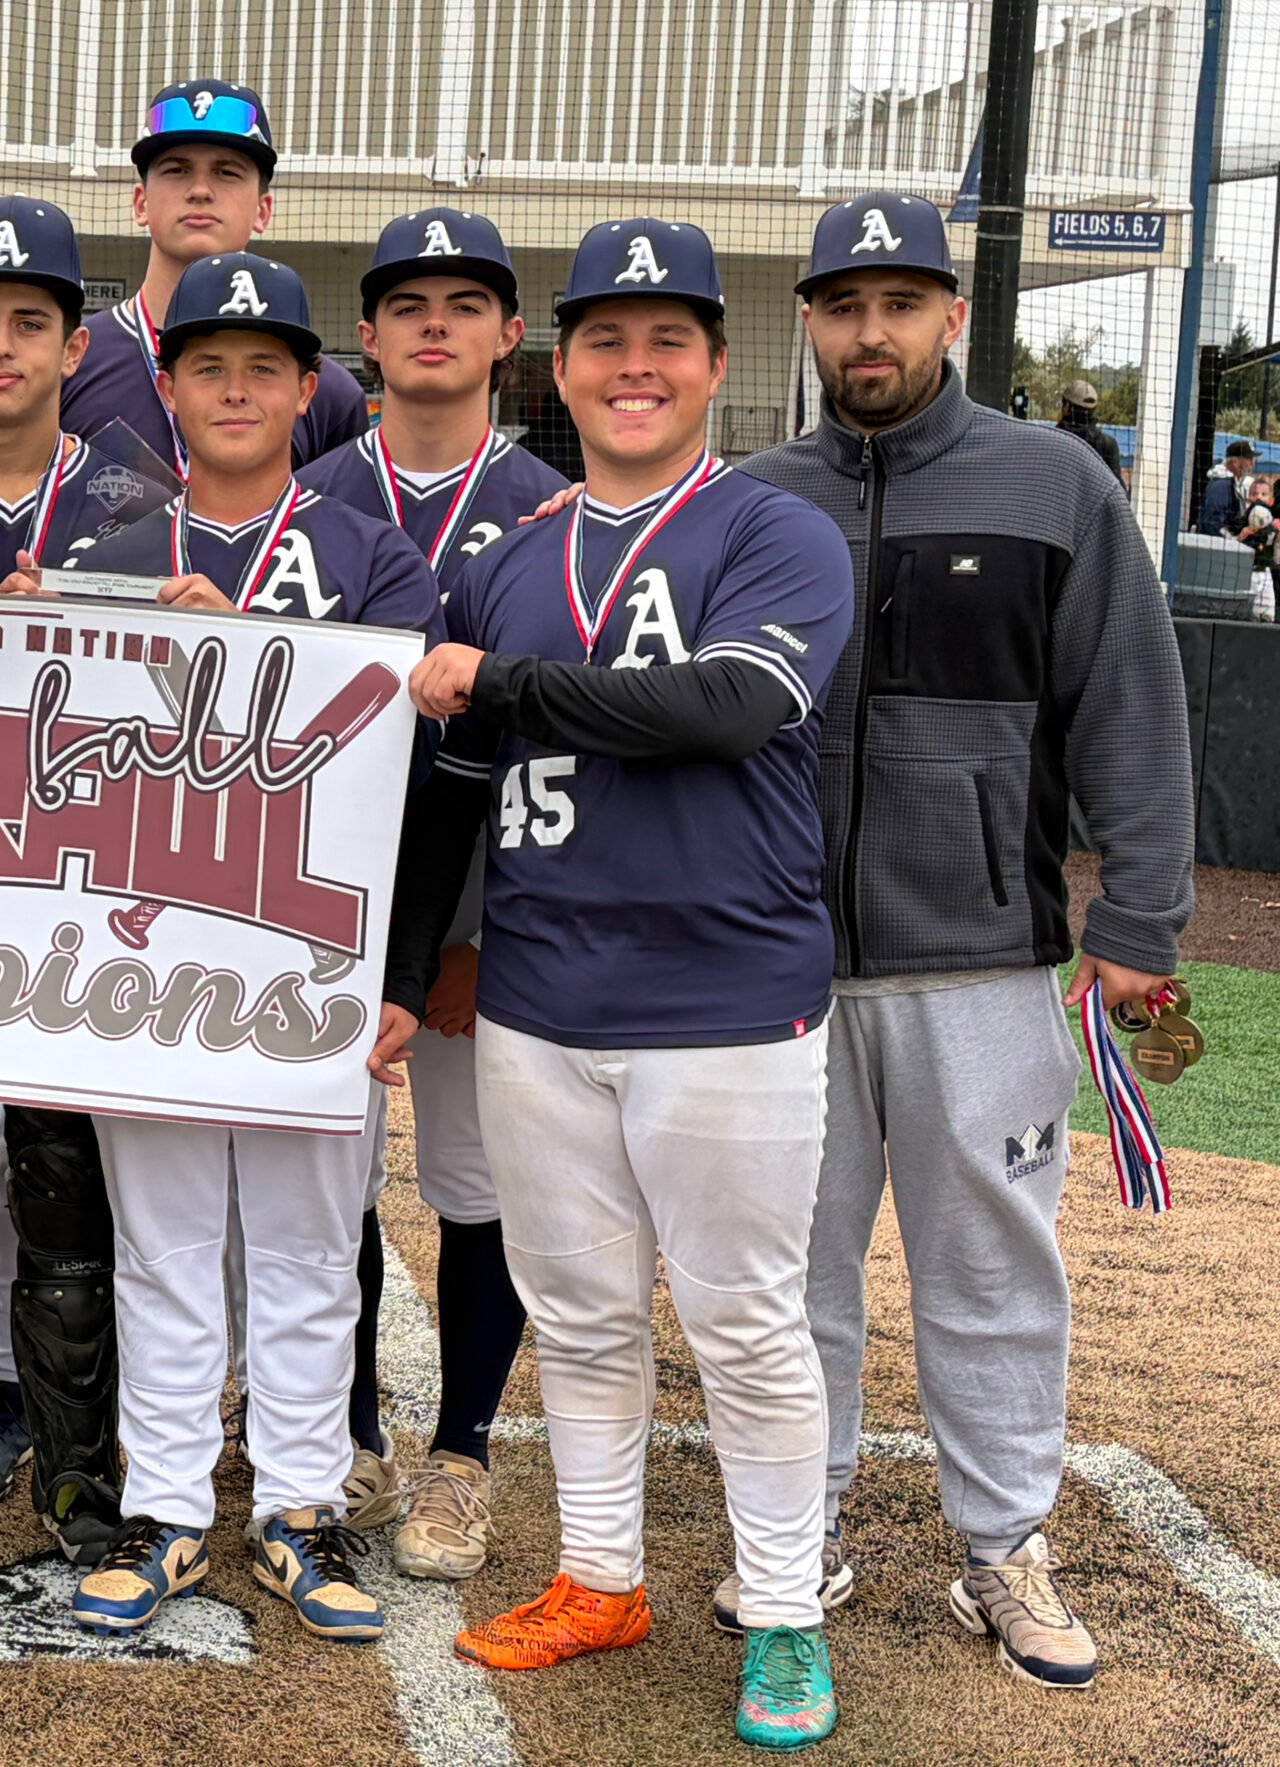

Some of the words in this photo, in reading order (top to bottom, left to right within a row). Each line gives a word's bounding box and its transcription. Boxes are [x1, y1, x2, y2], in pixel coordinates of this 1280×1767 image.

[417, 221, 461, 257] A
[851, 209, 902, 255] A
[1054, 213, 1110, 236] FIELDS
[615, 236, 668, 284] A
[219, 270, 268, 316] A
[88, 481, 142, 498] NATION
[251, 529, 341, 619] A
[611, 568, 691, 670] A
[26, 625, 171, 666] NATION
[26, 636, 335, 812] fall
[500, 756, 576, 849] 45
[1006, 1150, 1055, 1184] BASEBALL
